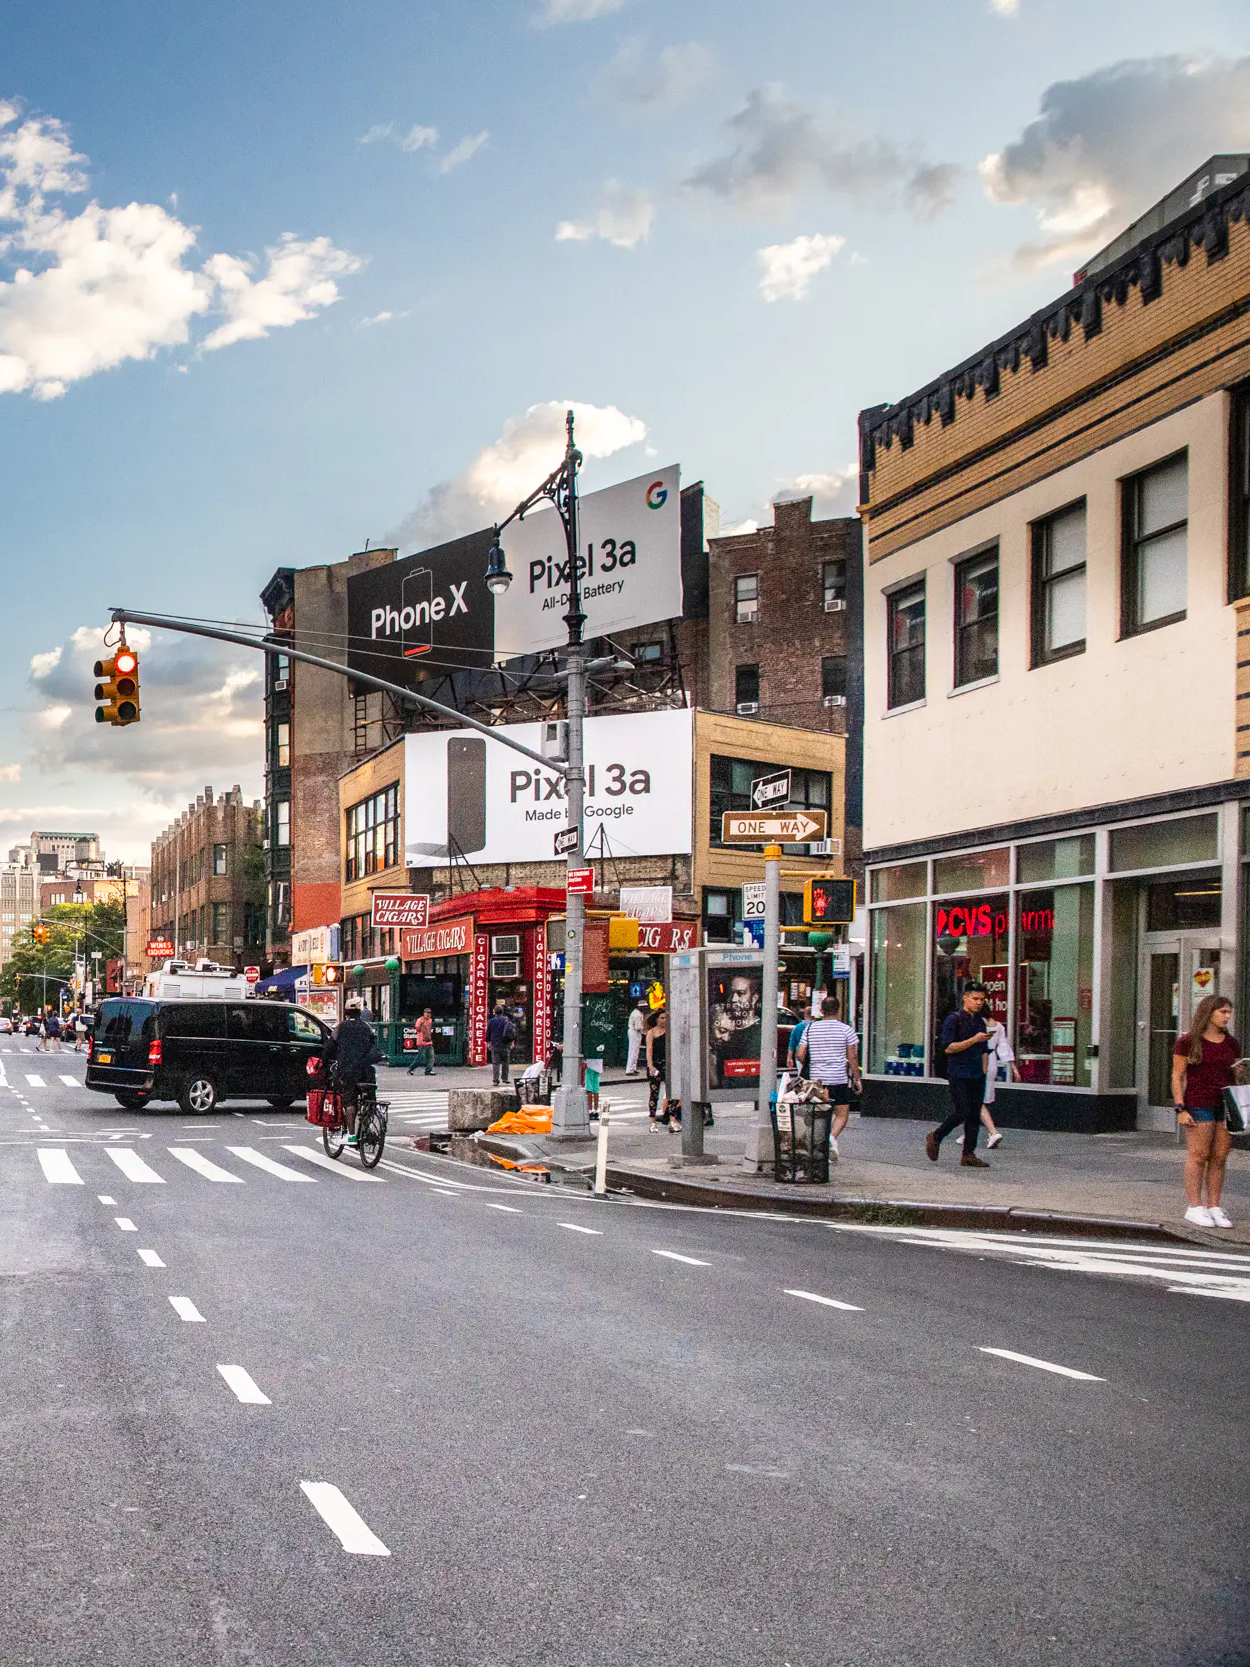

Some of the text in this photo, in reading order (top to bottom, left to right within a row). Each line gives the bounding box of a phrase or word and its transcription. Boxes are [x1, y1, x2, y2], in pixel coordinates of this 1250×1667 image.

[529, 538, 637, 594] Pixel 3a
[584, 580, 625, 600] Battery
[371, 580, 468, 640] Phone X
[605, 763, 651, 797] 3a
[756, 781, 785, 801] ONE WAY
[525, 808, 561, 822] Made
[584, 804, 634, 818] Google
[737, 821, 810, 834] ONE WAY
[745, 885, 766, 893] SPEED
[746, 892, 765, 900] LIMIT
[375, 899, 426, 911] VILLAGE
[746, 900, 766, 915] 20
[375, 911, 425, 925] CIGARS
[948, 904, 992, 937] CVS
[150, 941, 172, 949] WINES
[406, 926, 466, 954] VILLAGE CIGARS
[147, 948, 174, 956] LIQUORS
[722, 952, 753, 961] Phone
[714, 1002, 762, 1010] STRENGTH
[714, 1019, 761, 1027] OPTIONAL
